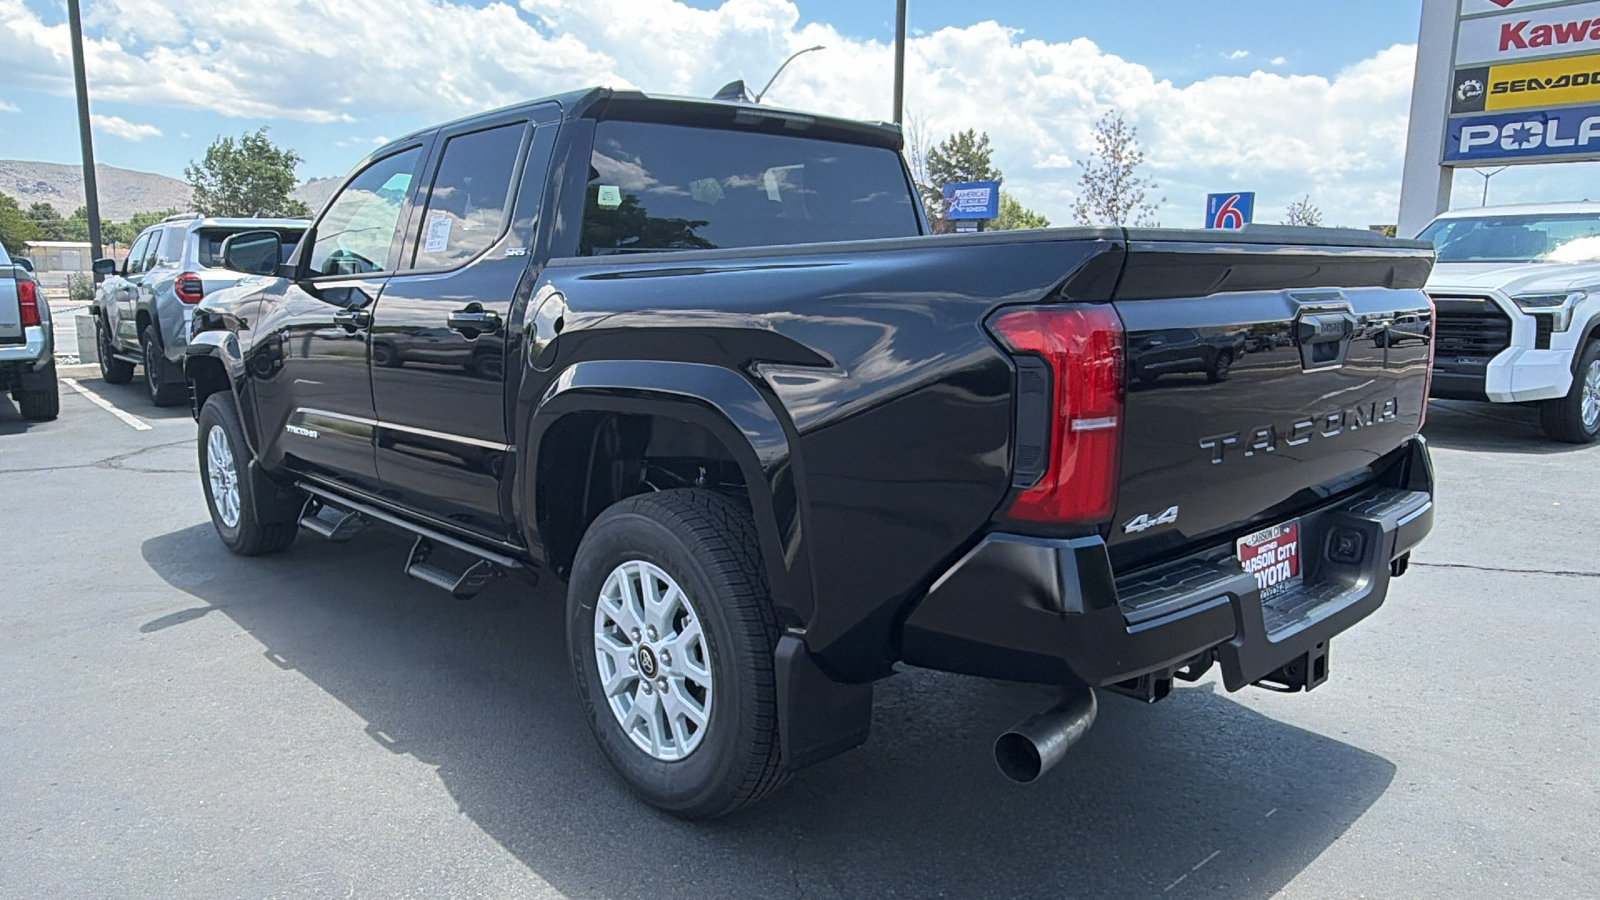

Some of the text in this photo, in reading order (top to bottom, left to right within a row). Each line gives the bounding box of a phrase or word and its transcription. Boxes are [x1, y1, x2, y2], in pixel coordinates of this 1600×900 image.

[1214, 194, 1243, 229] 6
[505, 247, 526, 256] SR5
[286, 424, 319, 438] TACOMA
[1200, 397, 1398, 464] TACOMA
[1252, 528, 1273, 543] CARSON
[1277, 541, 1297, 561] CITY
[1254, 560, 1291, 589] OYOTA
